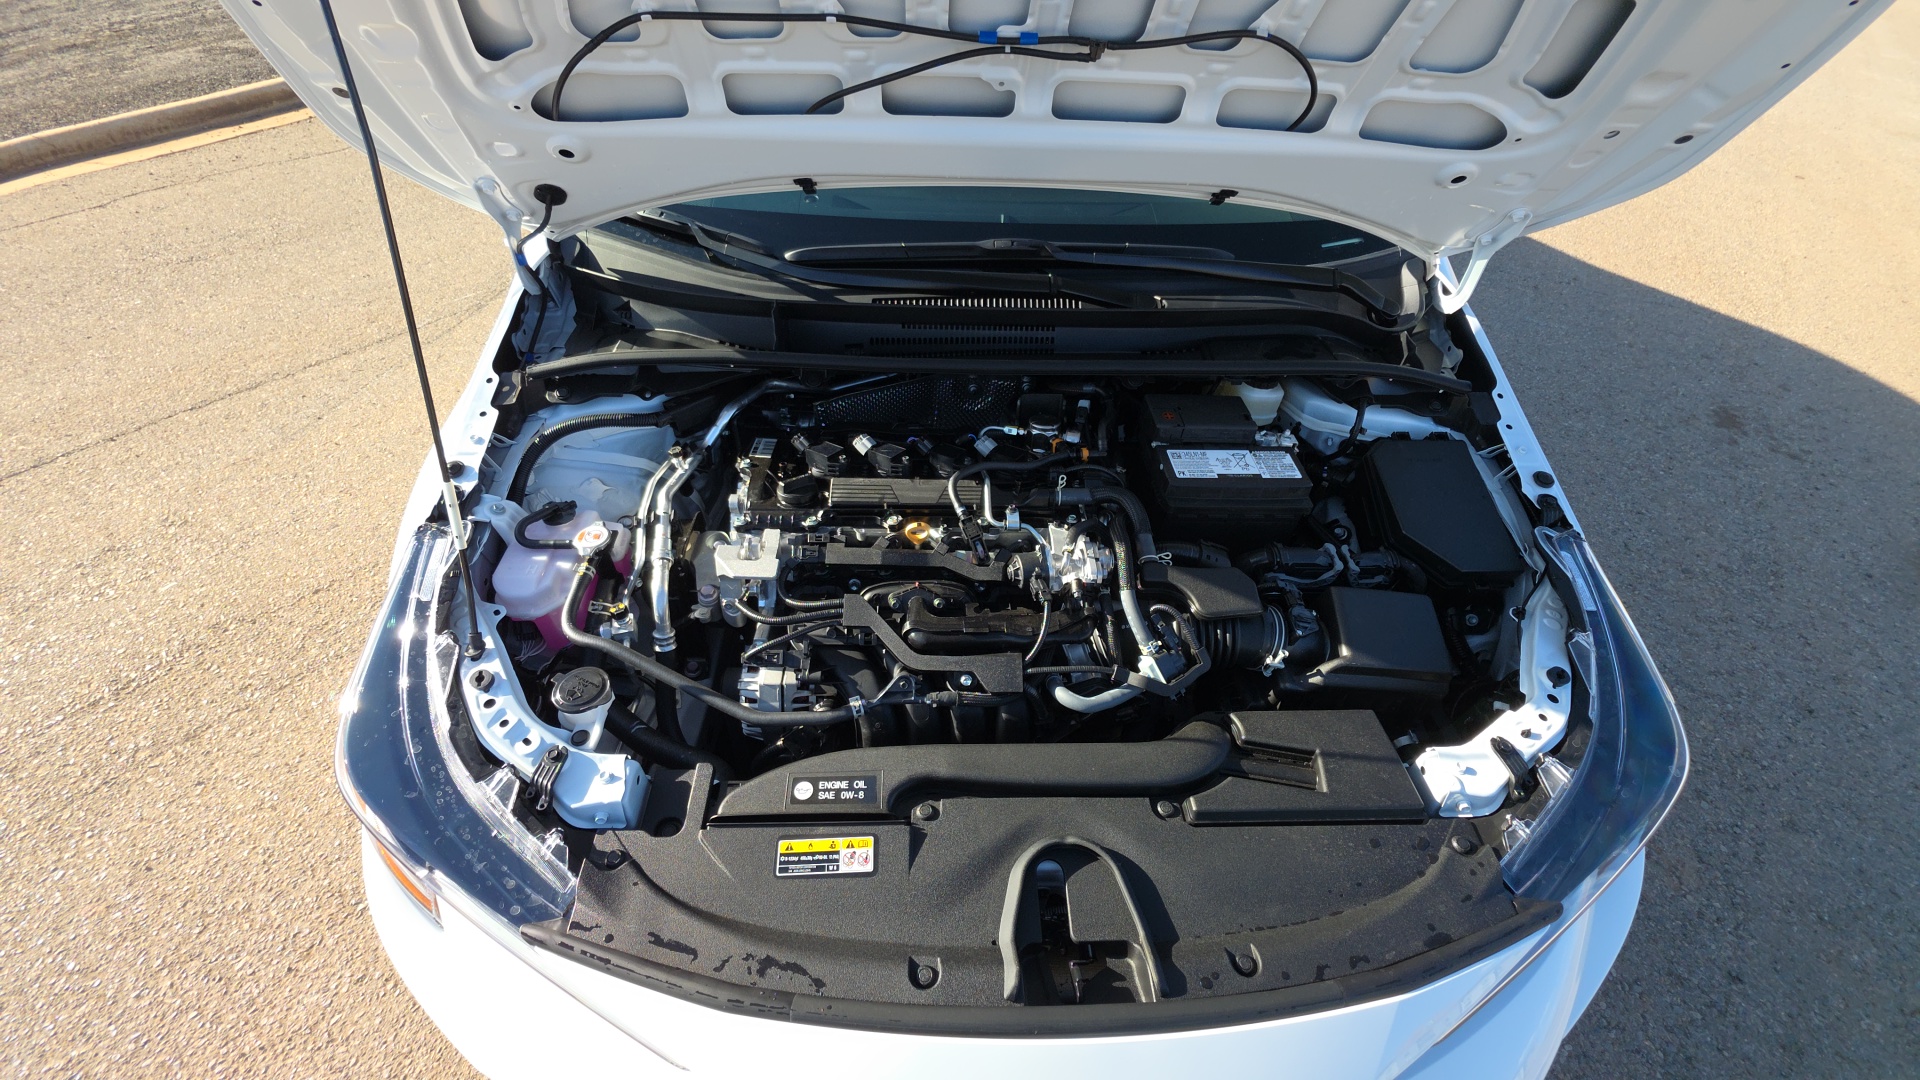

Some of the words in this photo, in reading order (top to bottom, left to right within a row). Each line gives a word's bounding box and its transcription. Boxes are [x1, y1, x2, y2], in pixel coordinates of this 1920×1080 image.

[818, 780, 849, 790] ENGINE
[853, 780, 867, 789] OIL
[818, 791, 836, 800] SAE
[840, 790, 865, 800] 0W-8
